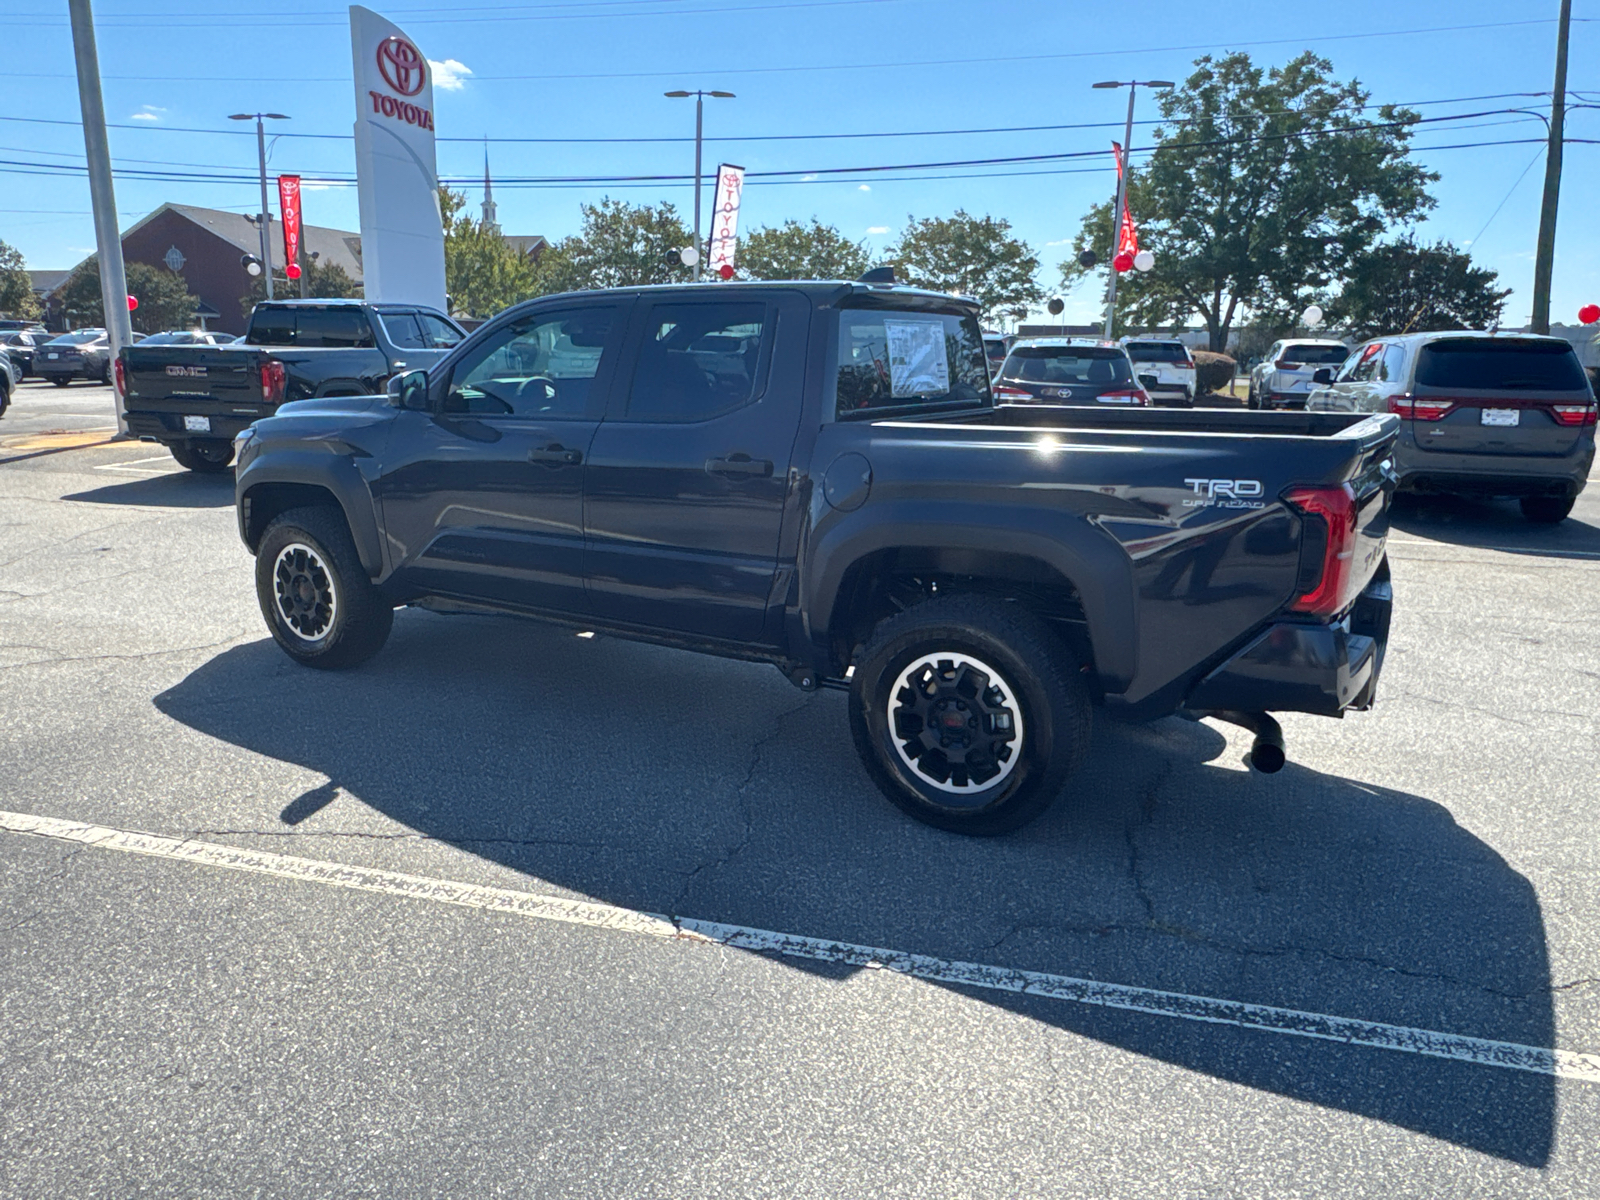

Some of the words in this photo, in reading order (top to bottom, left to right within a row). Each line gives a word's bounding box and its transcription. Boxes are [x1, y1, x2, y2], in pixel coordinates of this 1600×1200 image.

[369, 90, 434, 131] TOYOTA
[284, 196, 297, 255] TOYOT
[717, 189, 734, 263] TOYOTA
[165, 365, 208, 377] GMC
[1184, 478, 1261, 499] TRD
